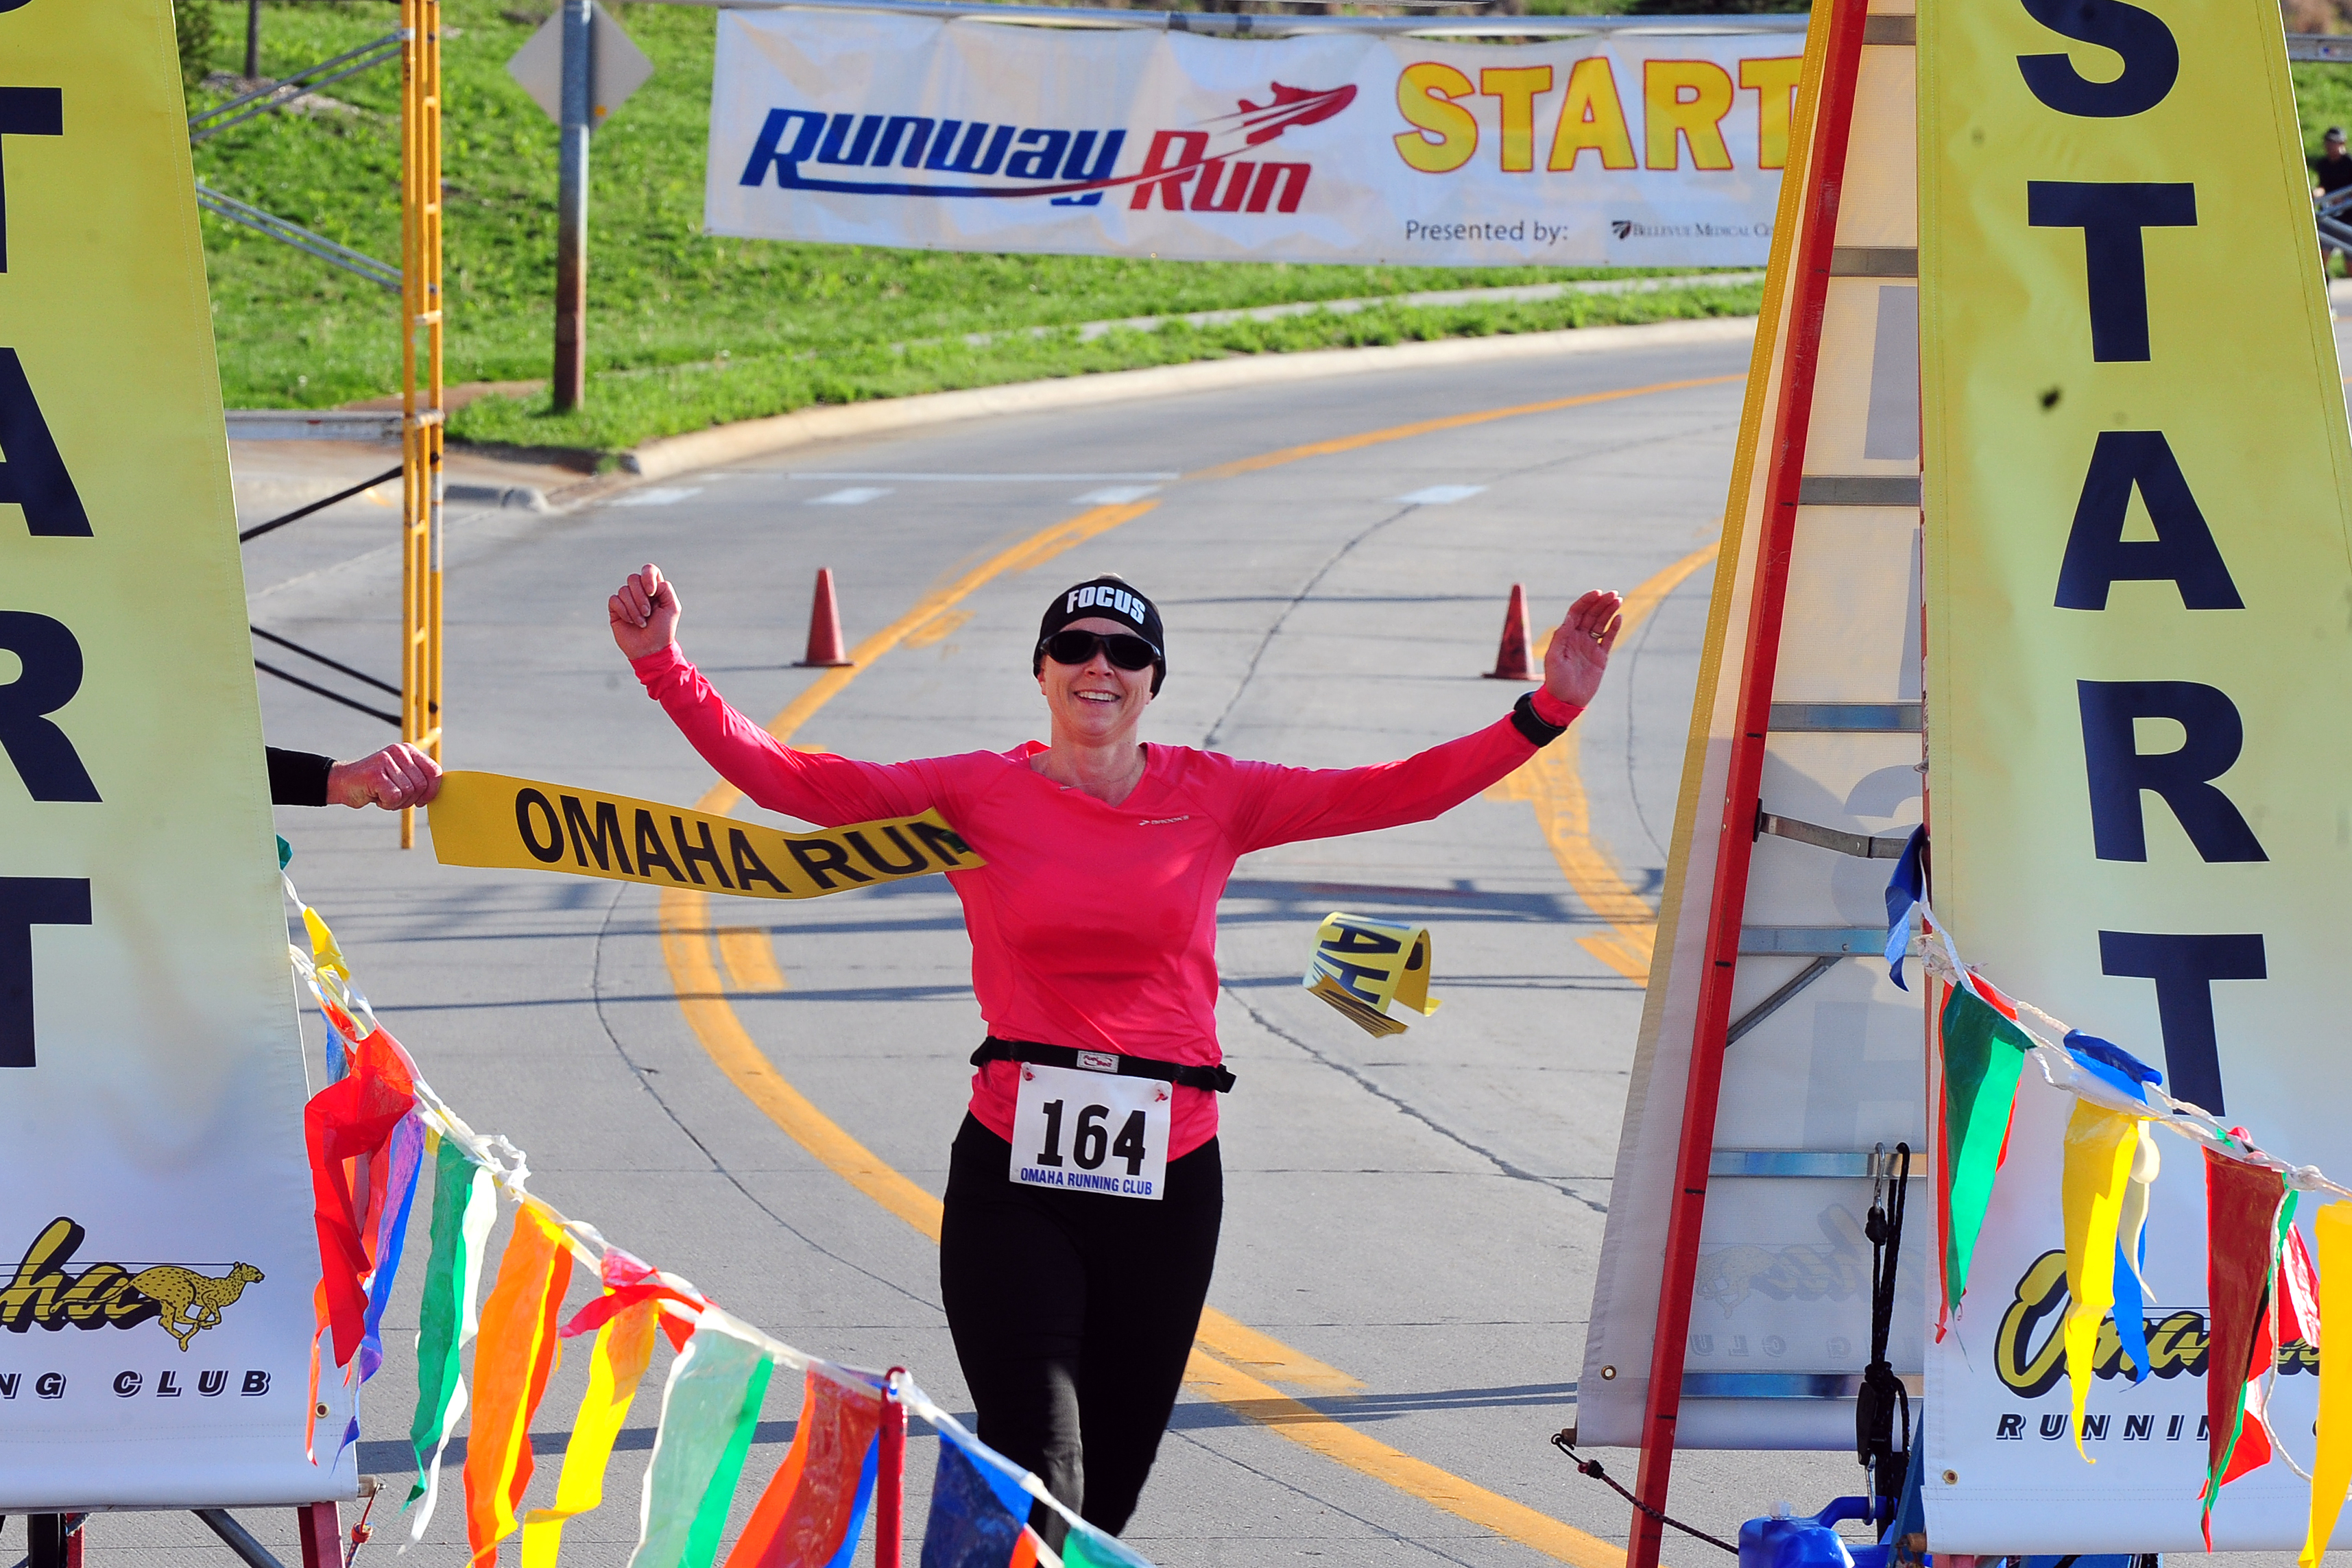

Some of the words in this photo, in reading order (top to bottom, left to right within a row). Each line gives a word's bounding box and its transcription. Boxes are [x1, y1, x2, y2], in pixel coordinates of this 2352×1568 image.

[1393, 56, 1804, 173] START
[1406, 219, 1525, 241] Presented
[1533, 219, 1568, 246] by:
[2016, 0, 2271, 1119] START
[1066, 586, 1146, 625] FOCUS
[515, 786, 793, 894] OMAHA
[1037, 1099, 1146, 1176] 164
[1020, 1167, 1064, 1185] OMAHA
[1067, 1172, 1119, 1192] RUNNING
[1123, 1179, 1153, 1196] CLUB
[112, 1370, 271, 1398] CLUB
[1996, 1414, 2211, 1441] RUNNI
